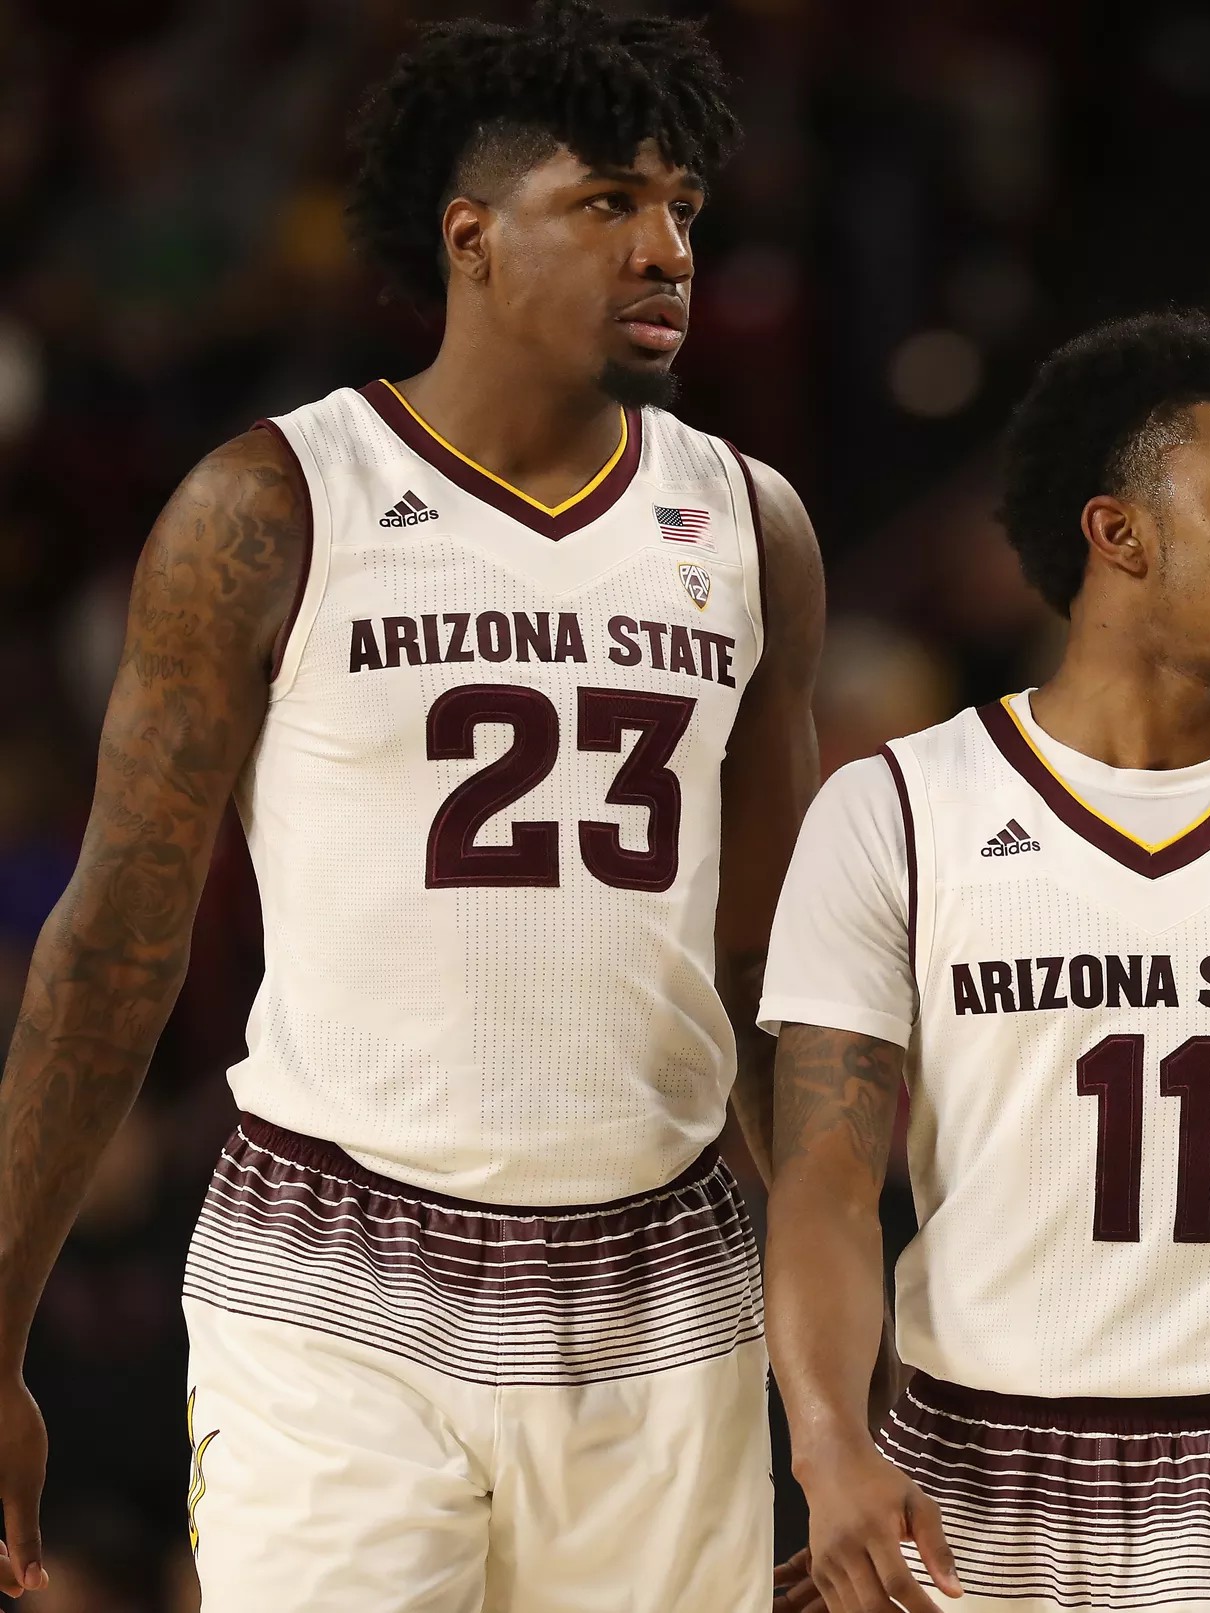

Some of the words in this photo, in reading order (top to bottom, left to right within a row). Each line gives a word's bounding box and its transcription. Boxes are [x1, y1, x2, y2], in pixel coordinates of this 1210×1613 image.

[379, 509, 439, 528] adidas
[688, 584, 708, 601] 12
[349, 610, 588, 674] ARIZONA
[607, 615, 737, 689] STATE
[425, 683, 699, 894] 23
[980, 840, 1041, 857] adidas
[950, 953, 1180, 1016] ARIZONA
